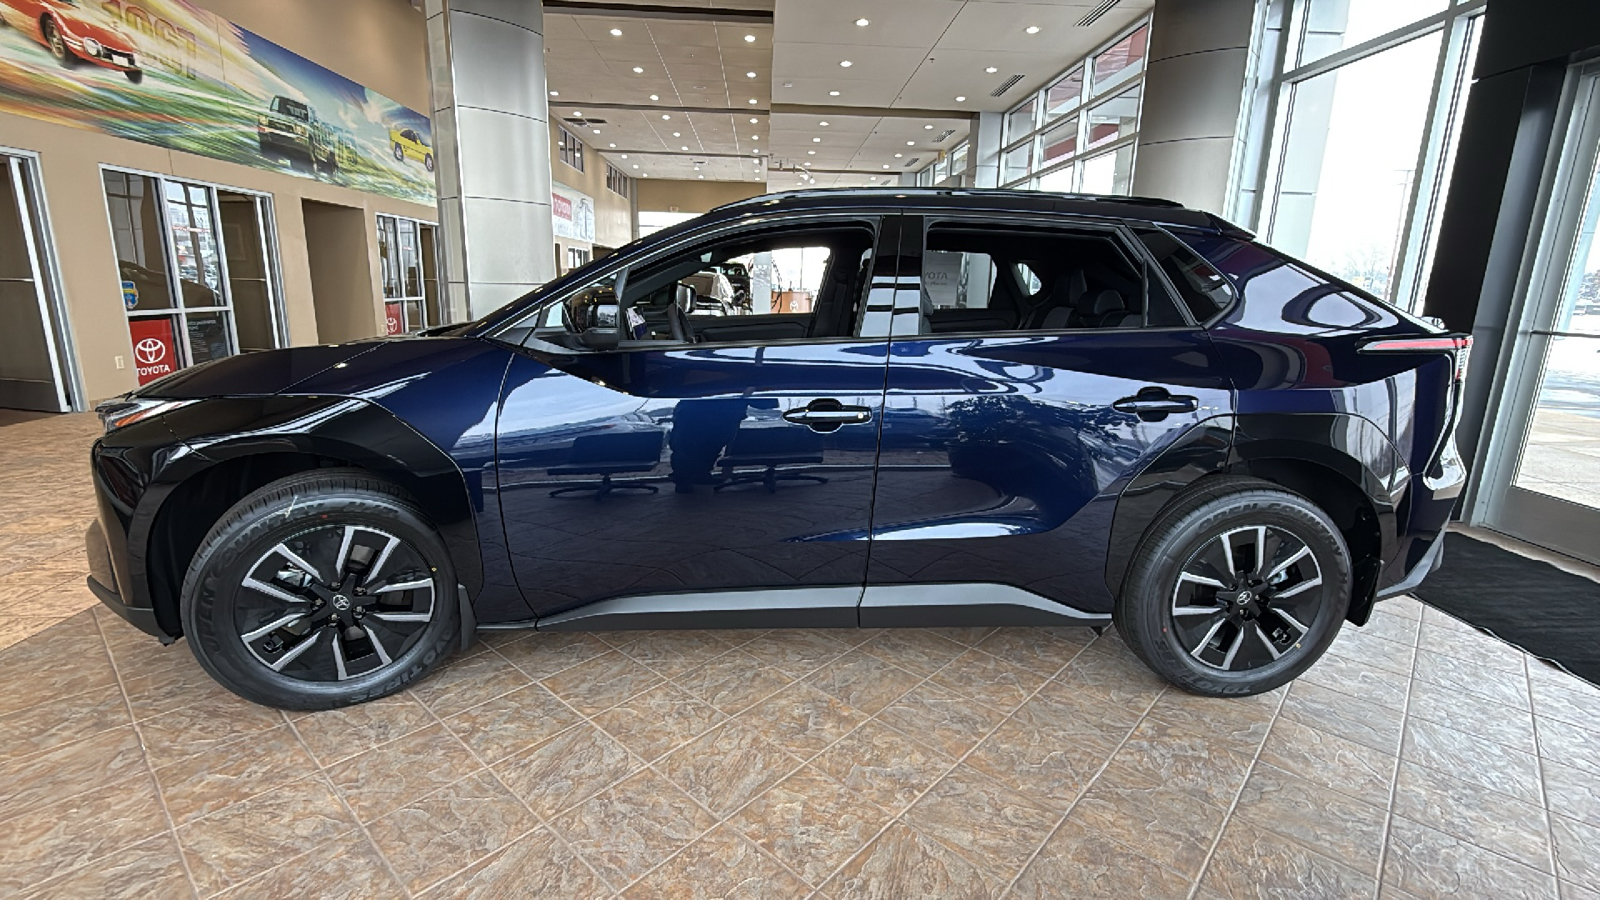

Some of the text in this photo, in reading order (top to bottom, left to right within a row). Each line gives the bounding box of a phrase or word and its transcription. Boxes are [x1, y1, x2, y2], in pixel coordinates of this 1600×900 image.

[137, 364, 171, 376] TOYOTA
[1199, 502, 1258, 532] OPEN
[1267, 502, 1343, 557] COUNTRY
